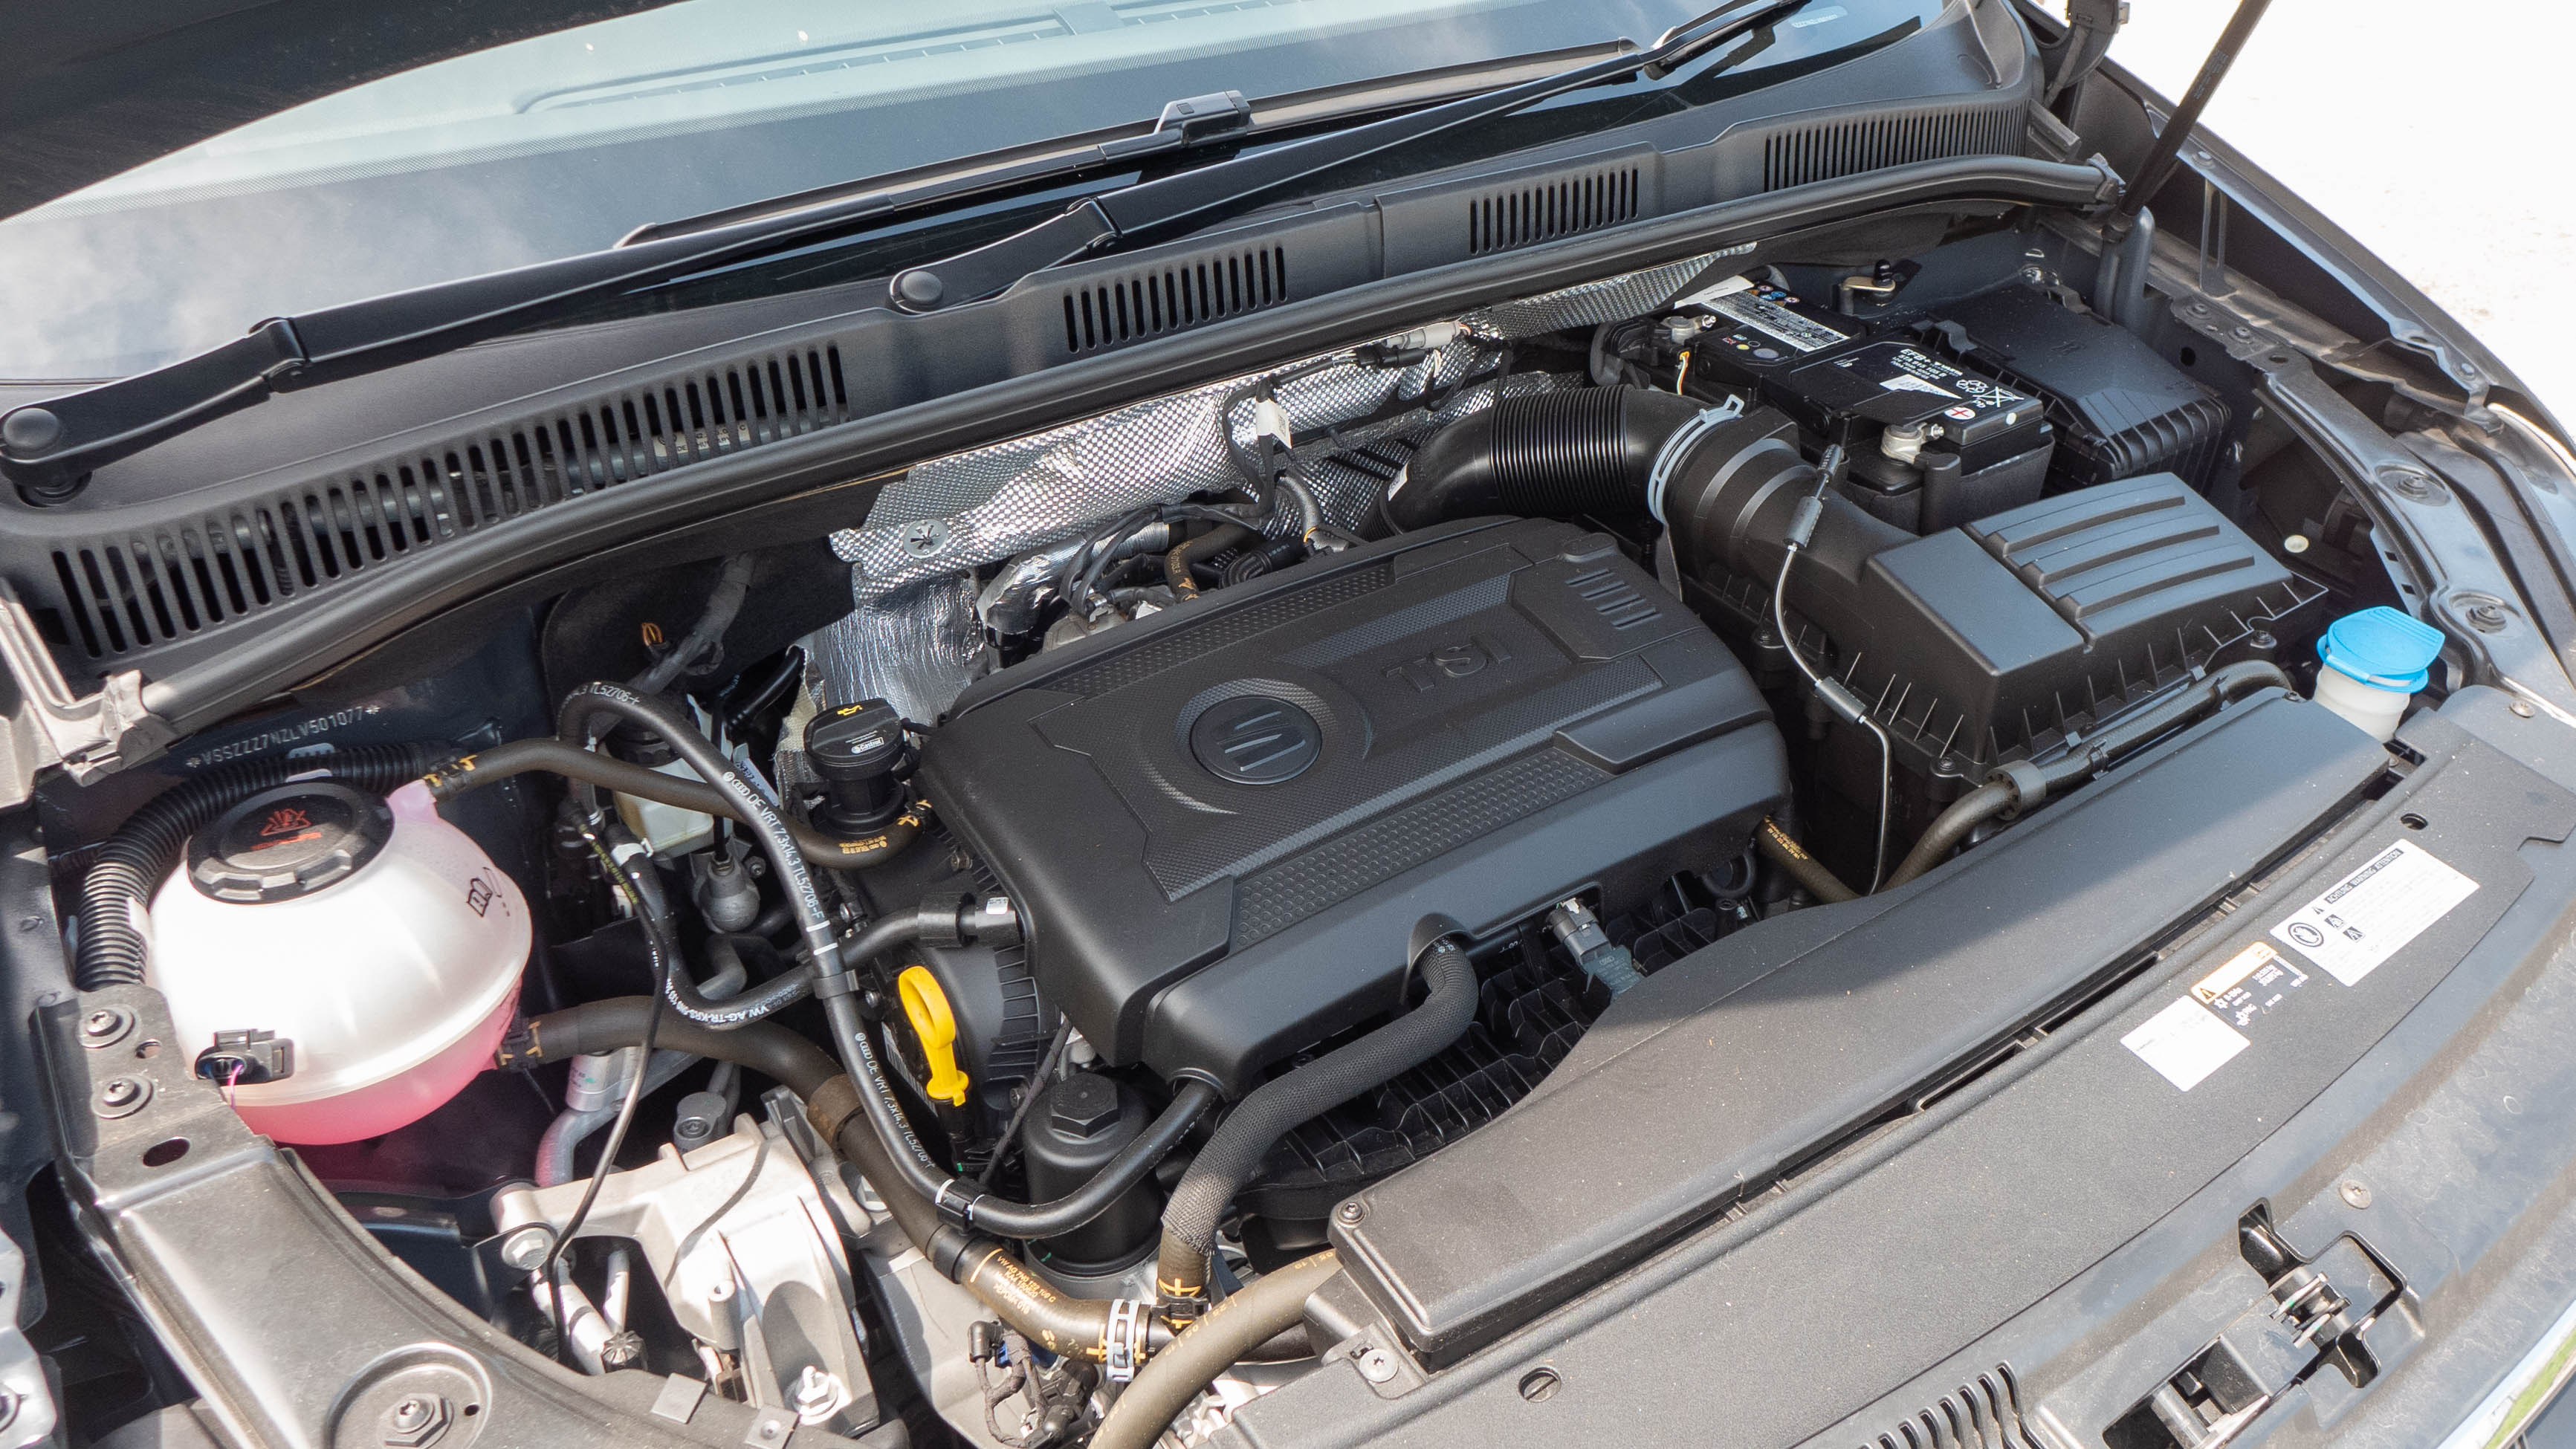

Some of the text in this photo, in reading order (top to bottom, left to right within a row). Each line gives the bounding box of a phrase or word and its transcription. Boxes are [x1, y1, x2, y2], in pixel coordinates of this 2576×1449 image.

[1900, 349, 1931, 363] EFB+
[1381, 635, 1512, 693] TSI
[760, 805, 782, 832] VRT
[792, 862, 825, 920] TL52706-F
[997, 1256, 1010, 1266] VW
